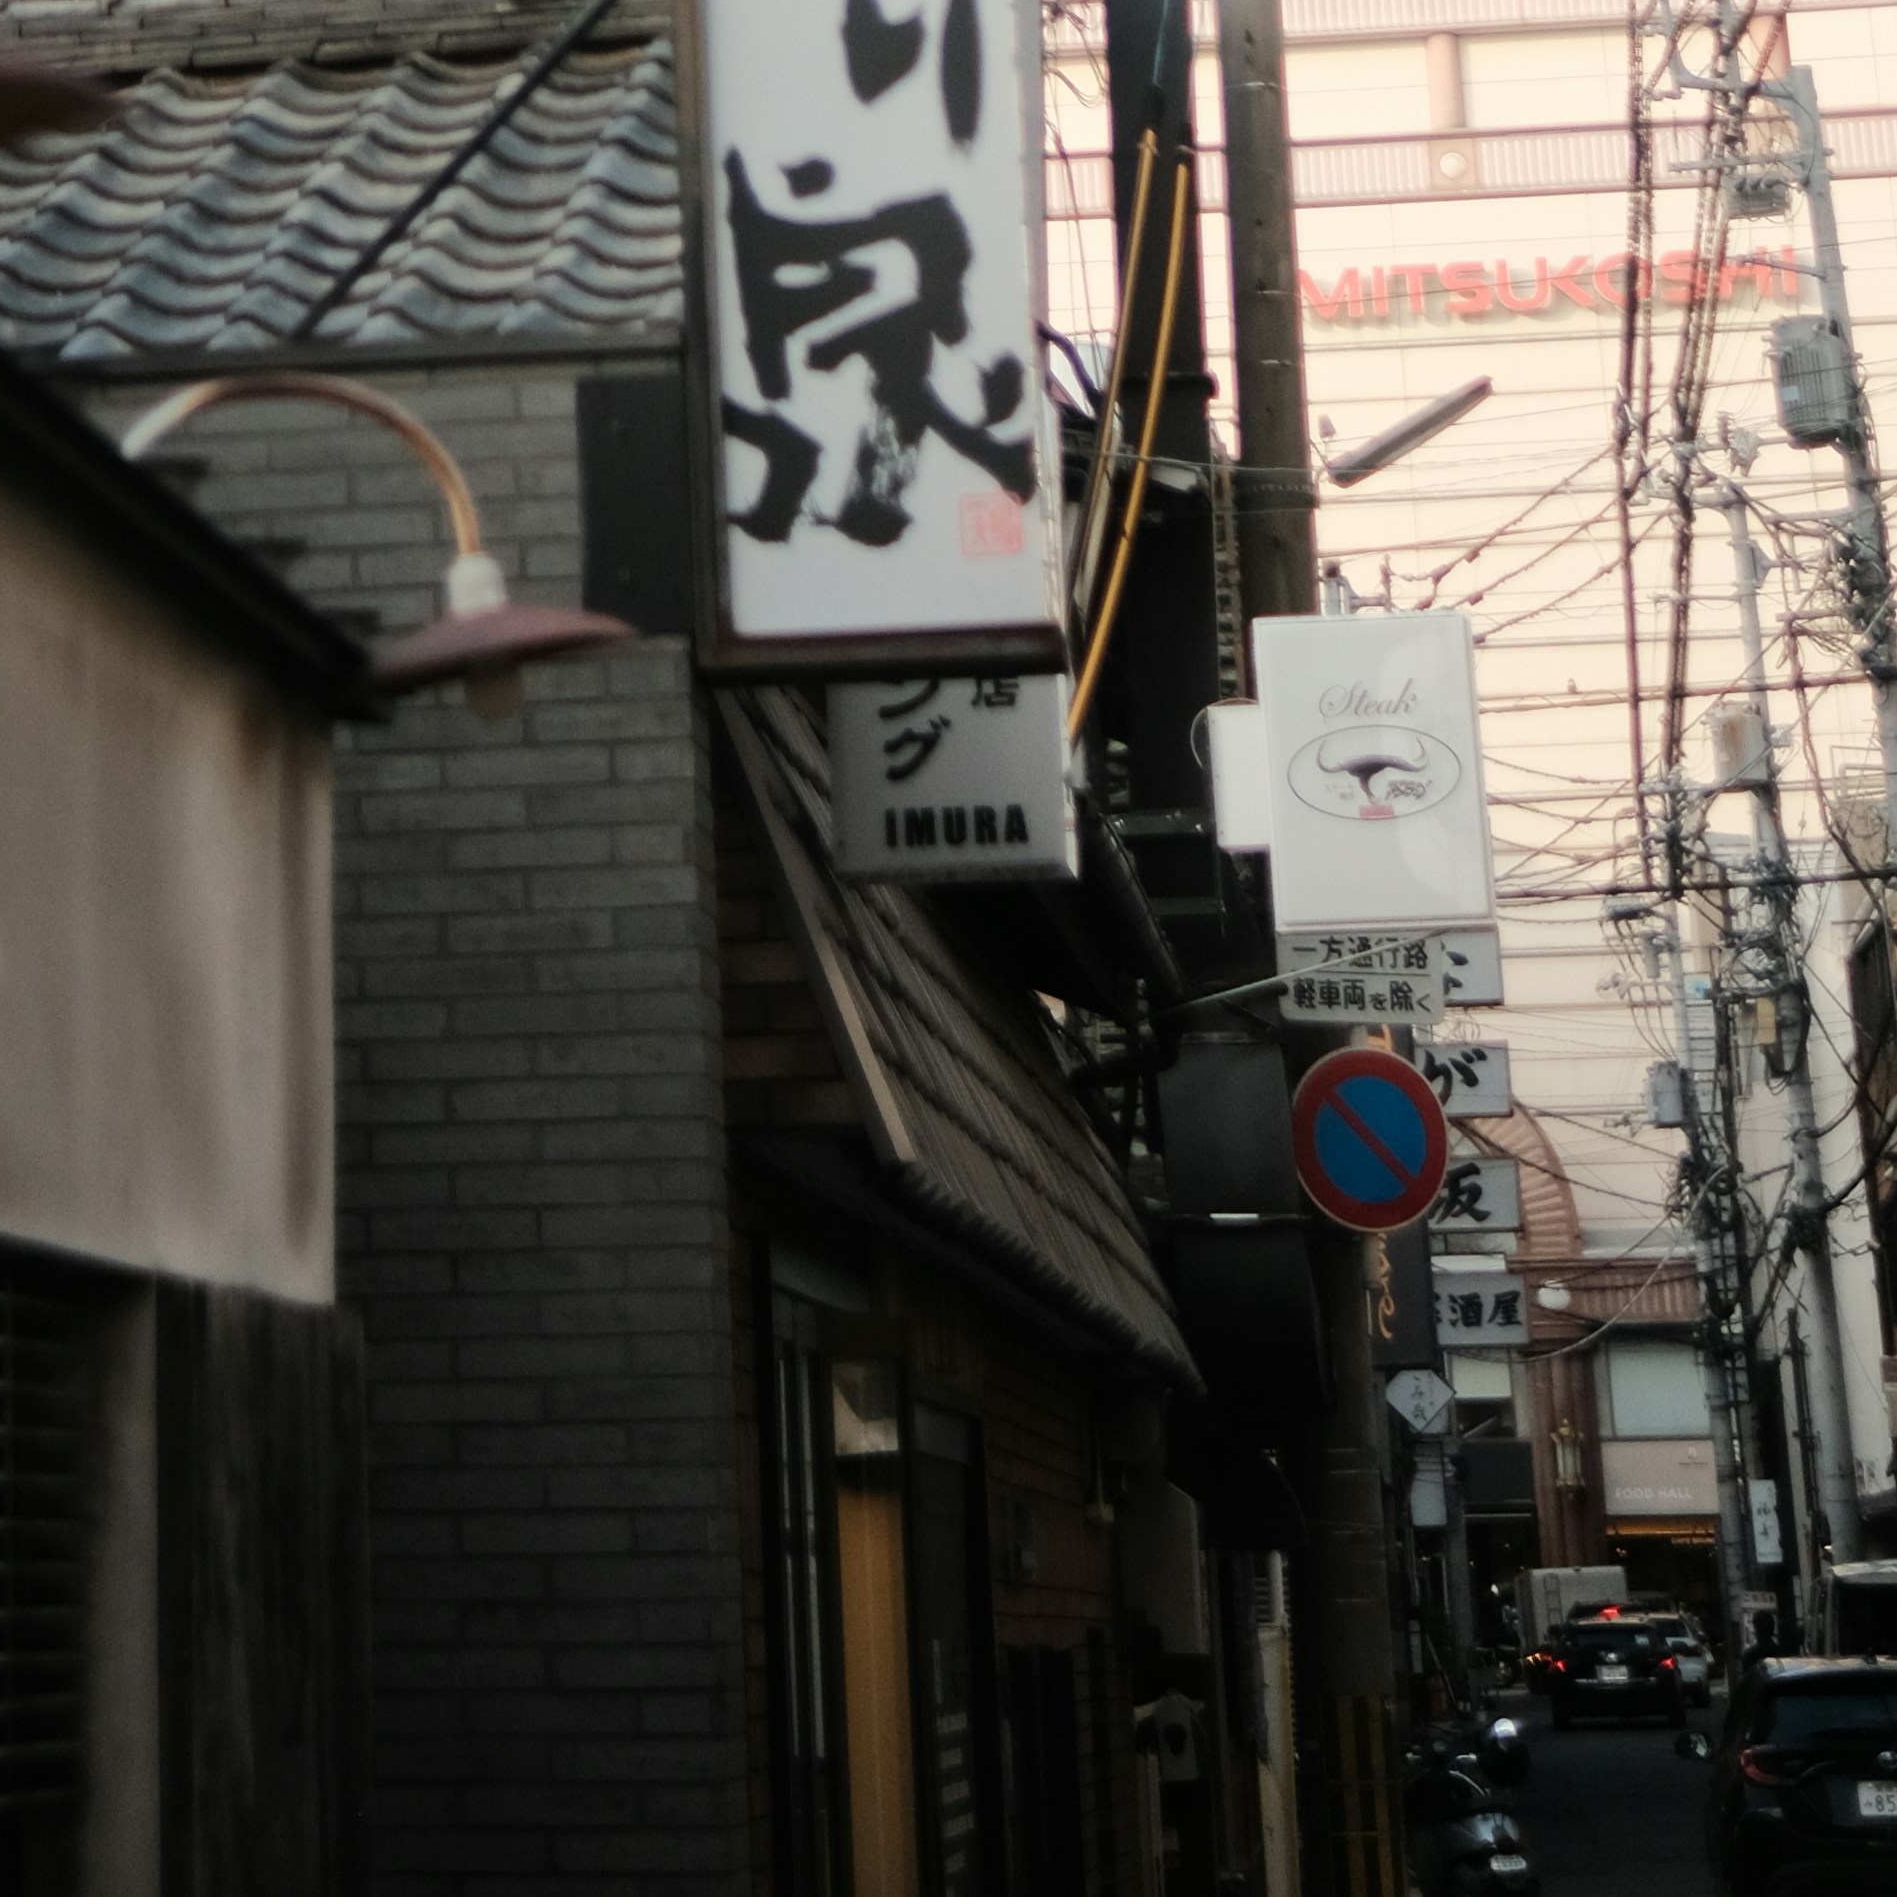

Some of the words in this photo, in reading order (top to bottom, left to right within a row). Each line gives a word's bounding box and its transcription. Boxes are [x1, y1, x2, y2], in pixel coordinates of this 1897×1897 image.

[1298, 243, 1800, 321] MITSUKOSHI
[1318, 677, 1419, 724] Steak
[884, 803, 1030, 848] IMURA
[1291, 935, 1429, 971] 一方通行路
[1292, 977, 1432, 1014] 軽車両を除く
[1433, 1289, 1523, 1329] 酒屋
[1614, 1487, 1653, 1500] FOOD
[1656, 1487, 1693, 1500] HALL
